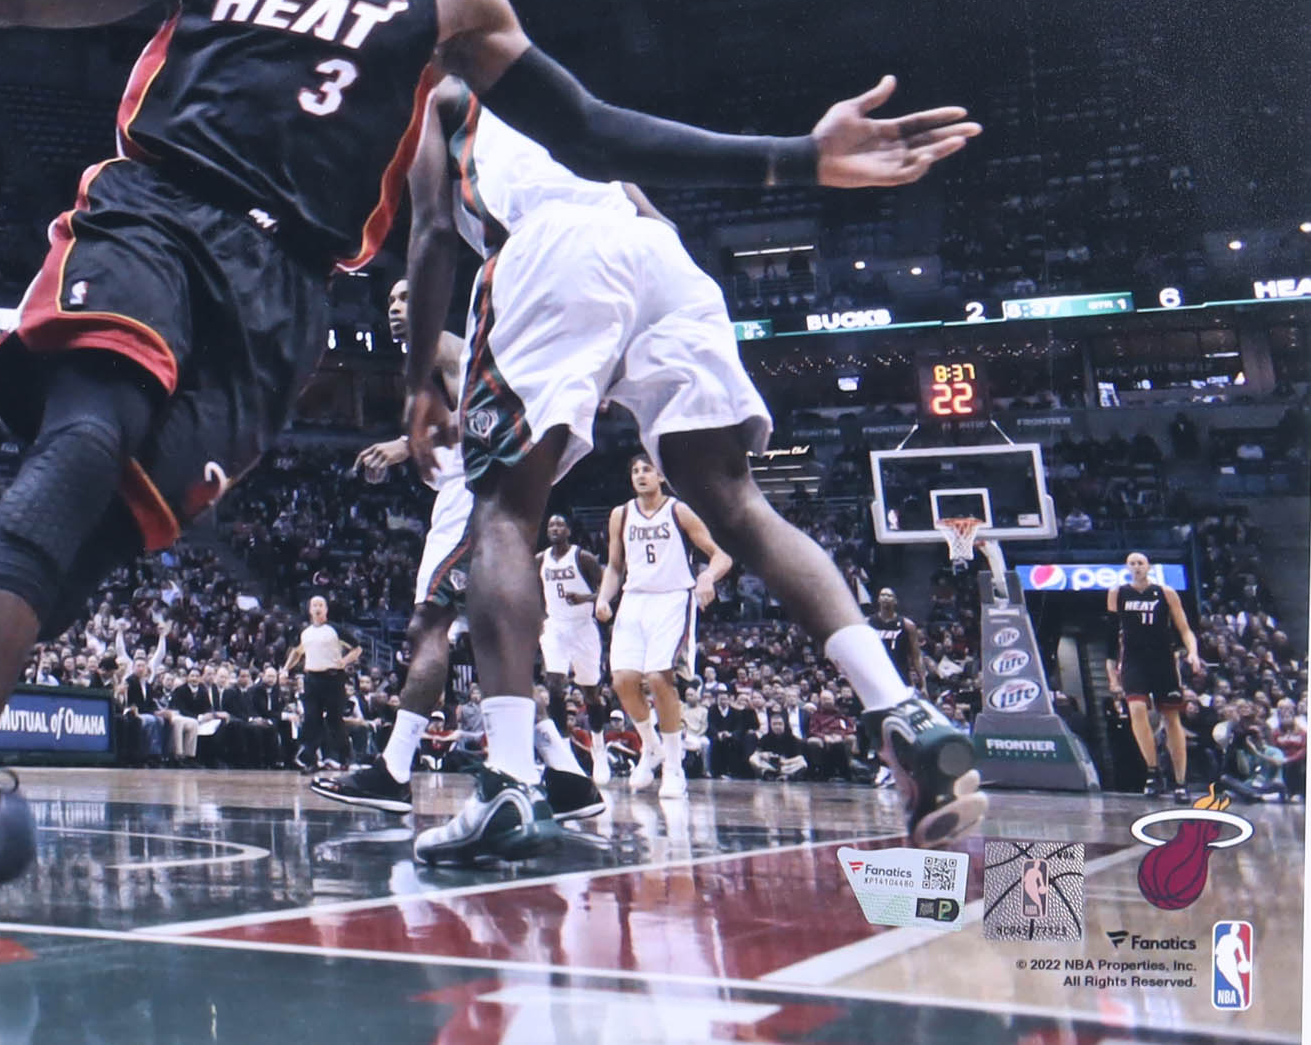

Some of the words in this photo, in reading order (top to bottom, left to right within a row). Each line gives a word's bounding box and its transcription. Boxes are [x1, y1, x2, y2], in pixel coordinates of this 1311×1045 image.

[297, 57, 359, 117] 3
[1158, 287, 1182, 309] 6
[1253, 278, 1311, 299] HEA
[806, 308, 892, 331] BUCKS
[965, 301, 986, 323] 2
[933, 364, 976, 383] 8:37
[932, 383, 974, 416] 22
[629, 522, 671, 542] BUCKS
[646, 543, 656, 564] 6
[1124, 599, 1160, 611] HEAT
[1140, 612, 1154, 625] 11
[1000, 687, 1035, 708] Lite
[50, 707, 65, 740] of
[65, 708, 106, 735] OMAHA
[985, 738, 1056, 752] FRONTIER
[865, 864, 912, 878] Fanatics
